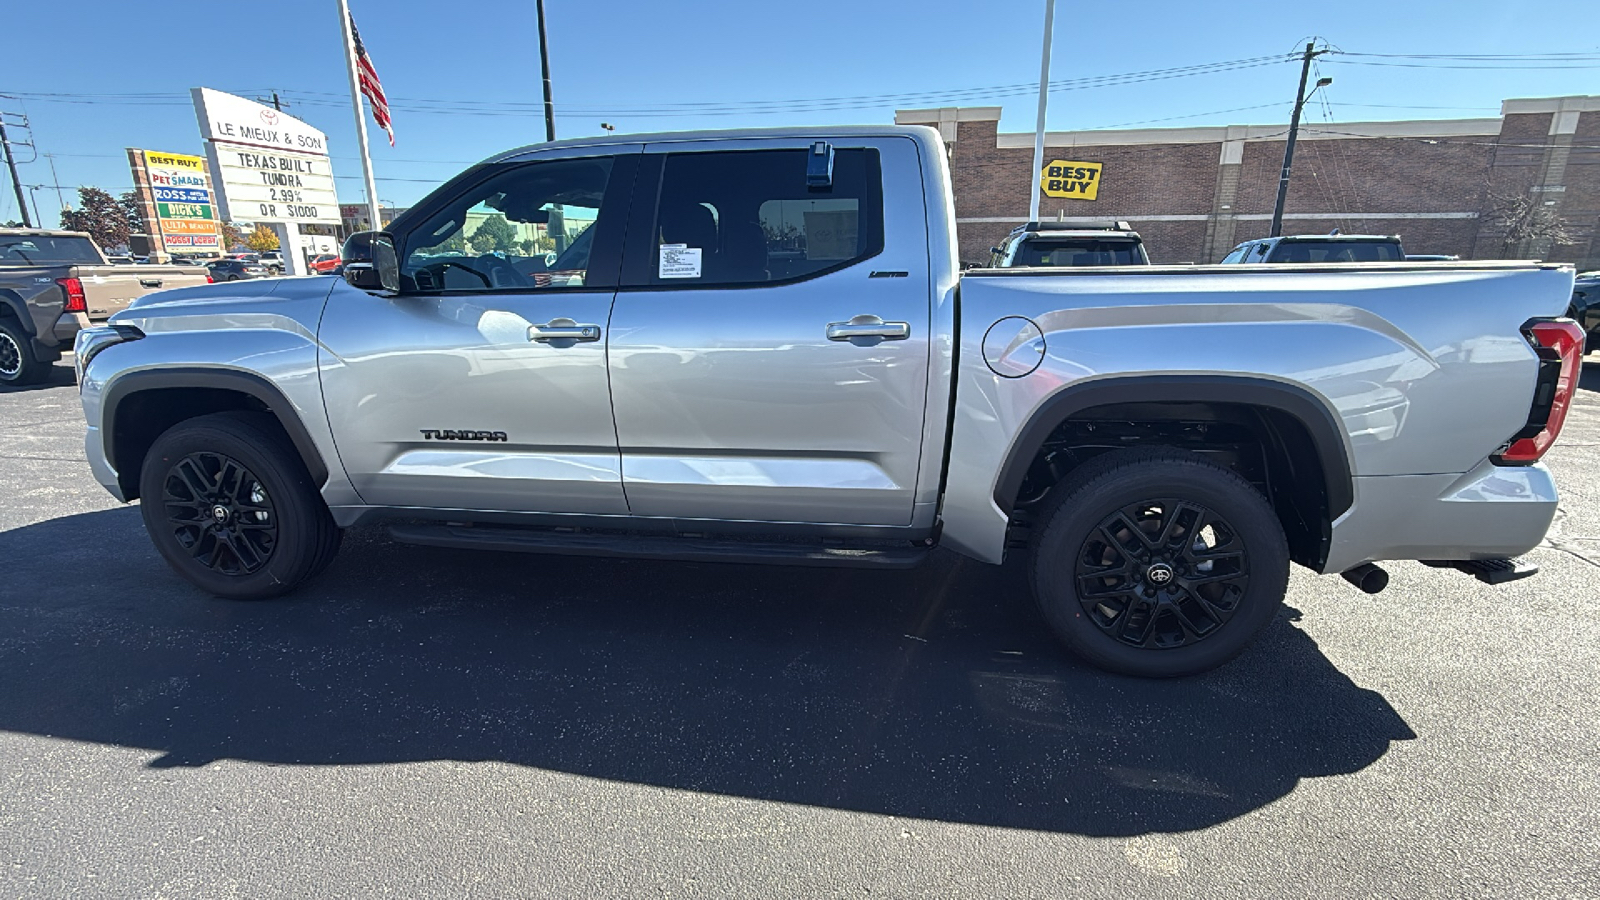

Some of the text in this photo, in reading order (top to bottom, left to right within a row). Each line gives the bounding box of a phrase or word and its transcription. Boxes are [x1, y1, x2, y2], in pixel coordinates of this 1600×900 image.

[217, 122, 322, 149] LE MIEUX & SON
[150, 156, 198, 167] BEST BUY
[238, 153, 313, 174] TEXAS BUILT
[260, 171, 303, 188] TUNDRA
[1048, 166, 1099, 180] BEST
[1048, 179, 1092, 193] BUY
[155, 189, 187, 200] ROSS
[269, 188, 303, 203] 2.99%
[168, 203, 203, 216] DICK'S
[260, 203, 277, 217] OR
[164, 220, 188, 229] ULTA
[420, 429, 508, 442] TUNDRA
